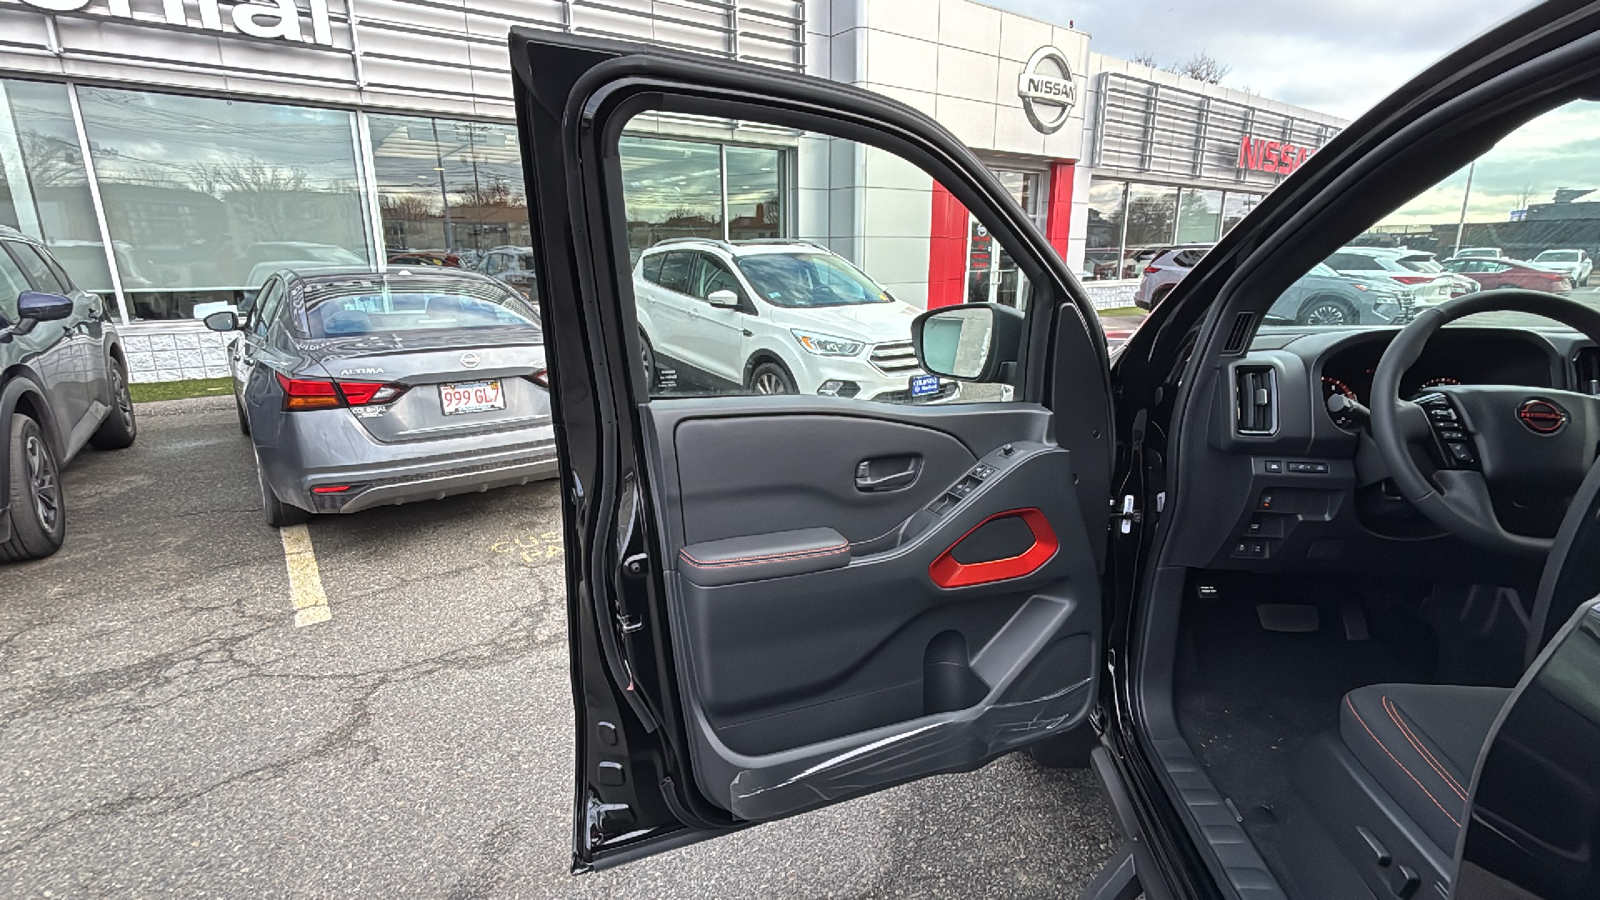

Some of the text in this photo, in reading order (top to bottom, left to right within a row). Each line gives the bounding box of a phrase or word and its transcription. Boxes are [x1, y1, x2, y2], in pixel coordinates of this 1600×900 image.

[1028, 77, 1076, 101] NISSAN
[1239, 136, 1317, 175] NISSA
[341, 367, 385, 376] ALTIMA
[444, 389, 471, 407] 999
